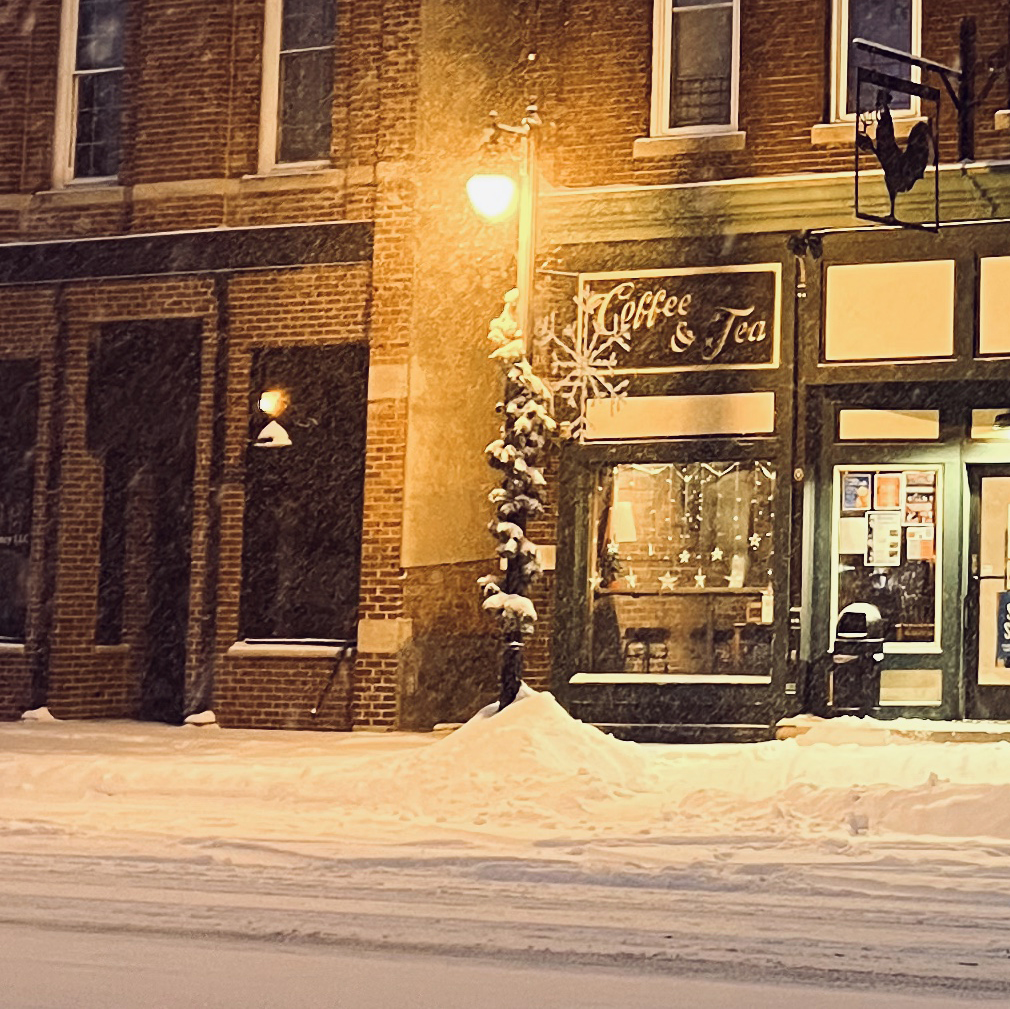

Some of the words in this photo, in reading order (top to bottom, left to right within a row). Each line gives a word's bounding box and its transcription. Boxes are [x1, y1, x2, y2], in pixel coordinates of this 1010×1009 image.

[586, 282, 692, 335] Coffee
[670, 321, 696, 353] &
[703, 305, 767, 361] Tea
